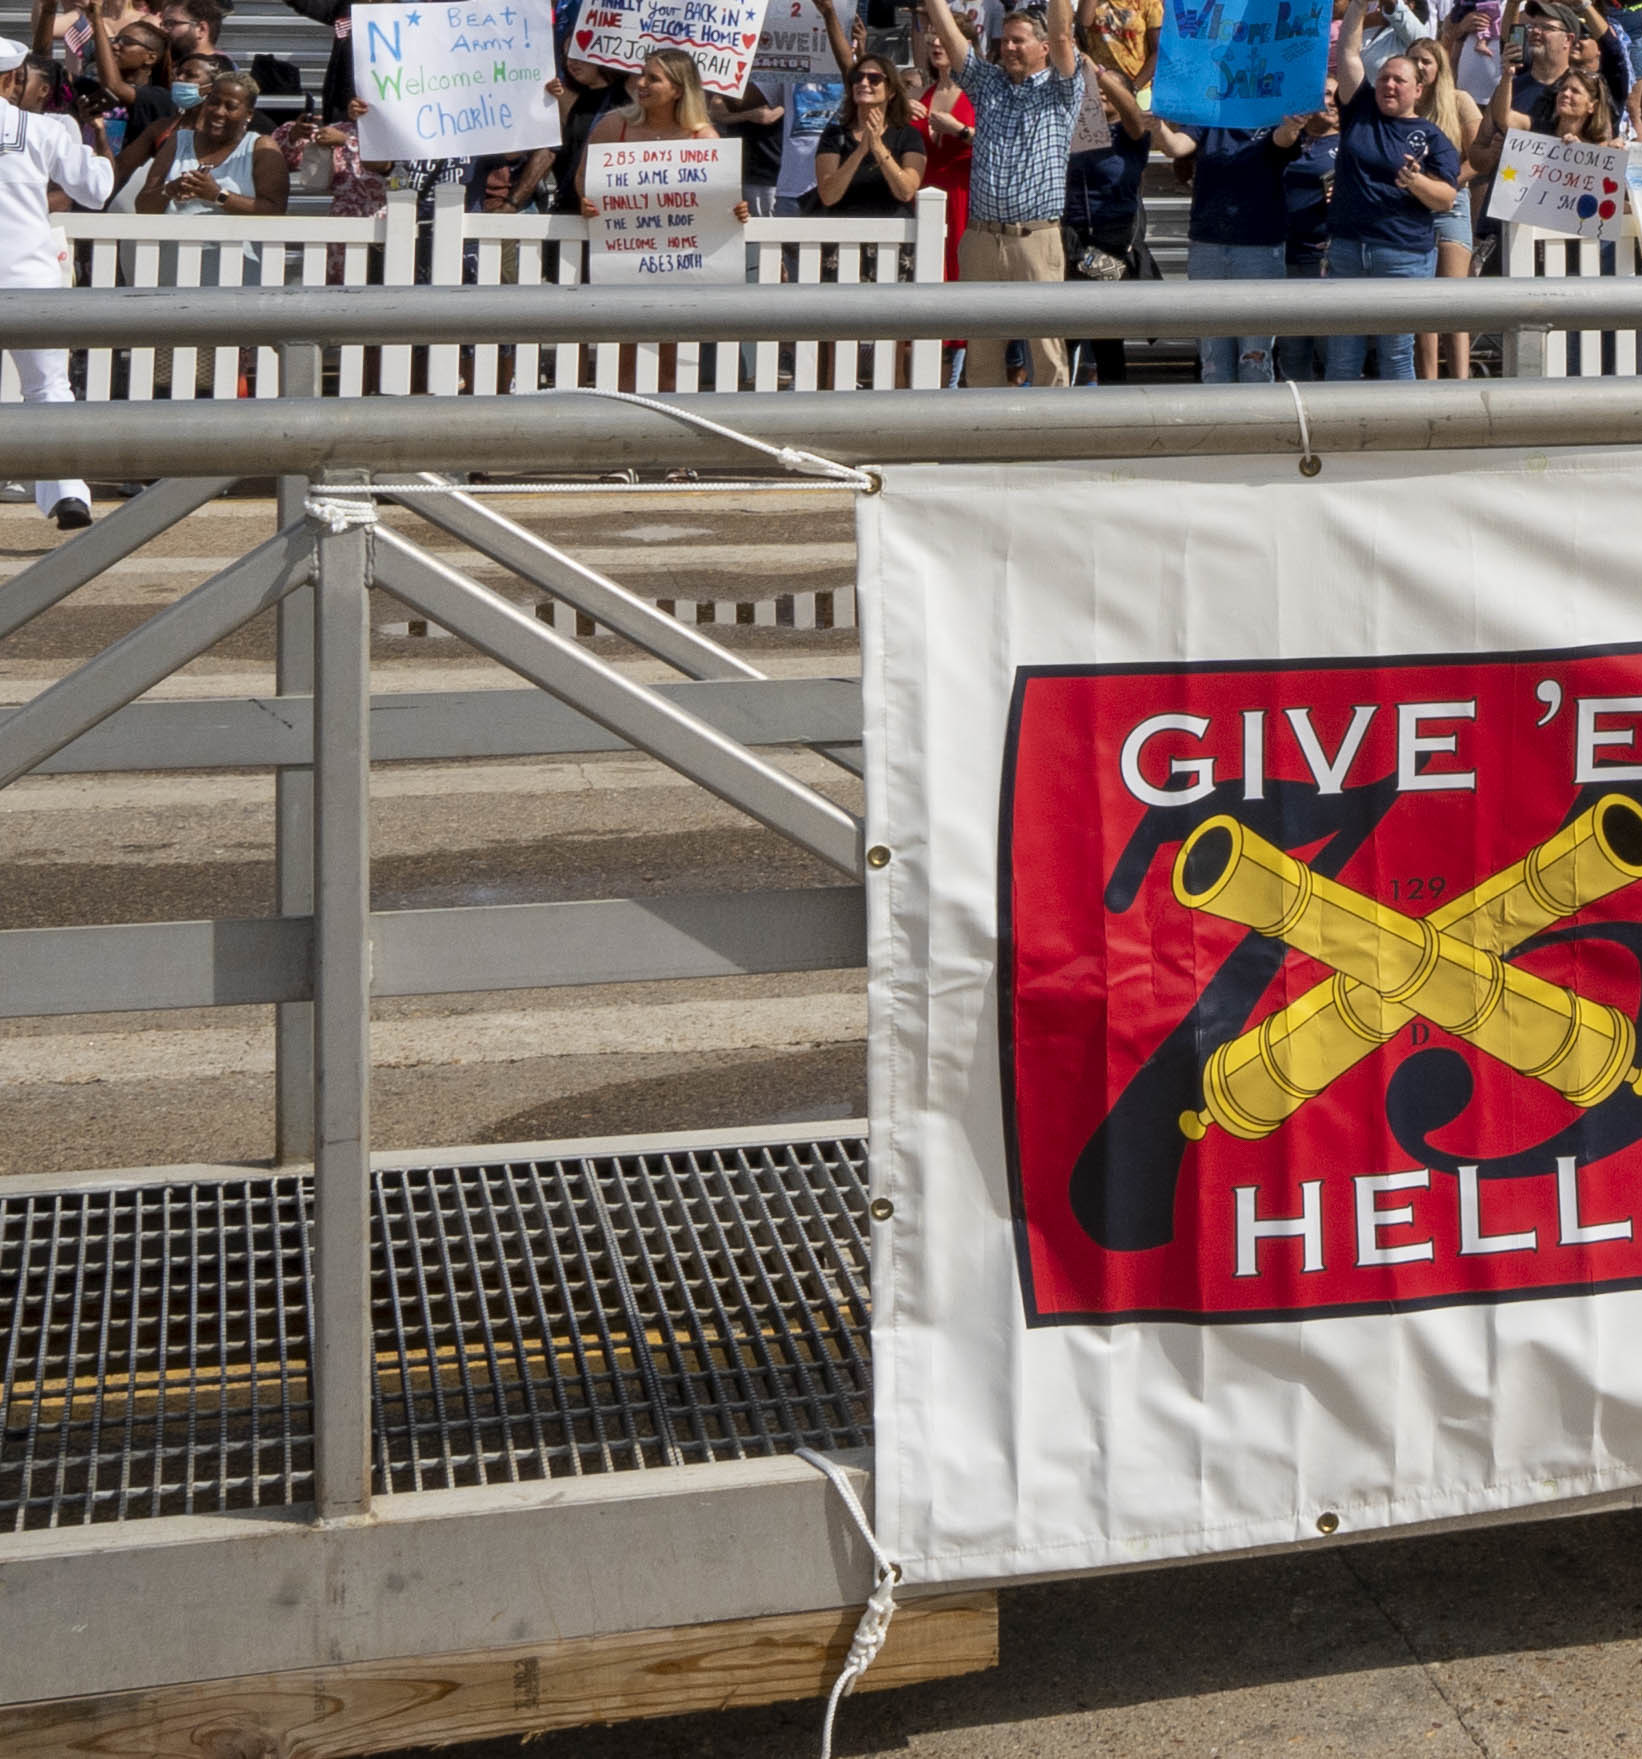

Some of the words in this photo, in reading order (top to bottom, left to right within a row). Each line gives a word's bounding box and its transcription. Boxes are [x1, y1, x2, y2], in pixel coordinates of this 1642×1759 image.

[684, 1, 718, 24] BACK
[585, 9, 623, 29] MINE
[640, 18, 697, 38] WELCOME
[701, 27, 741, 47] HOME
[589, 35, 622, 56] AT2
[371, 65, 485, 101] Welcome
[493, 60, 542, 84] Home
[603, 151, 636, 168] 285
[643, 150, 672, 163] DAYS
[680, 148, 719, 163] UNDER
[1508, 138, 1617, 172] WELCOME
[606, 173, 629, 188] THE
[637, 168, 669, 186] SAME
[678, 167, 707, 183] STARS
[1528, 163, 1596, 191] HOME
[602, 193, 649, 212] FINALLY
[657, 191, 700, 209] UNDER
[605, 218, 627, 231] THE
[636, 214, 663, 229] SAME
[668, 214, 696, 227] ROOF
[605, 237, 658, 251] WELCOME
[667, 236, 699, 249] HOME
[677, 253, 703, 271] ROTH
[1118, 695, 1478, 808] GIVE
[1389, 875, 1448, 902] 129
[1410, 1022, 1431, 1047] D
[1231, 1153, 1635, 1278] HELL
